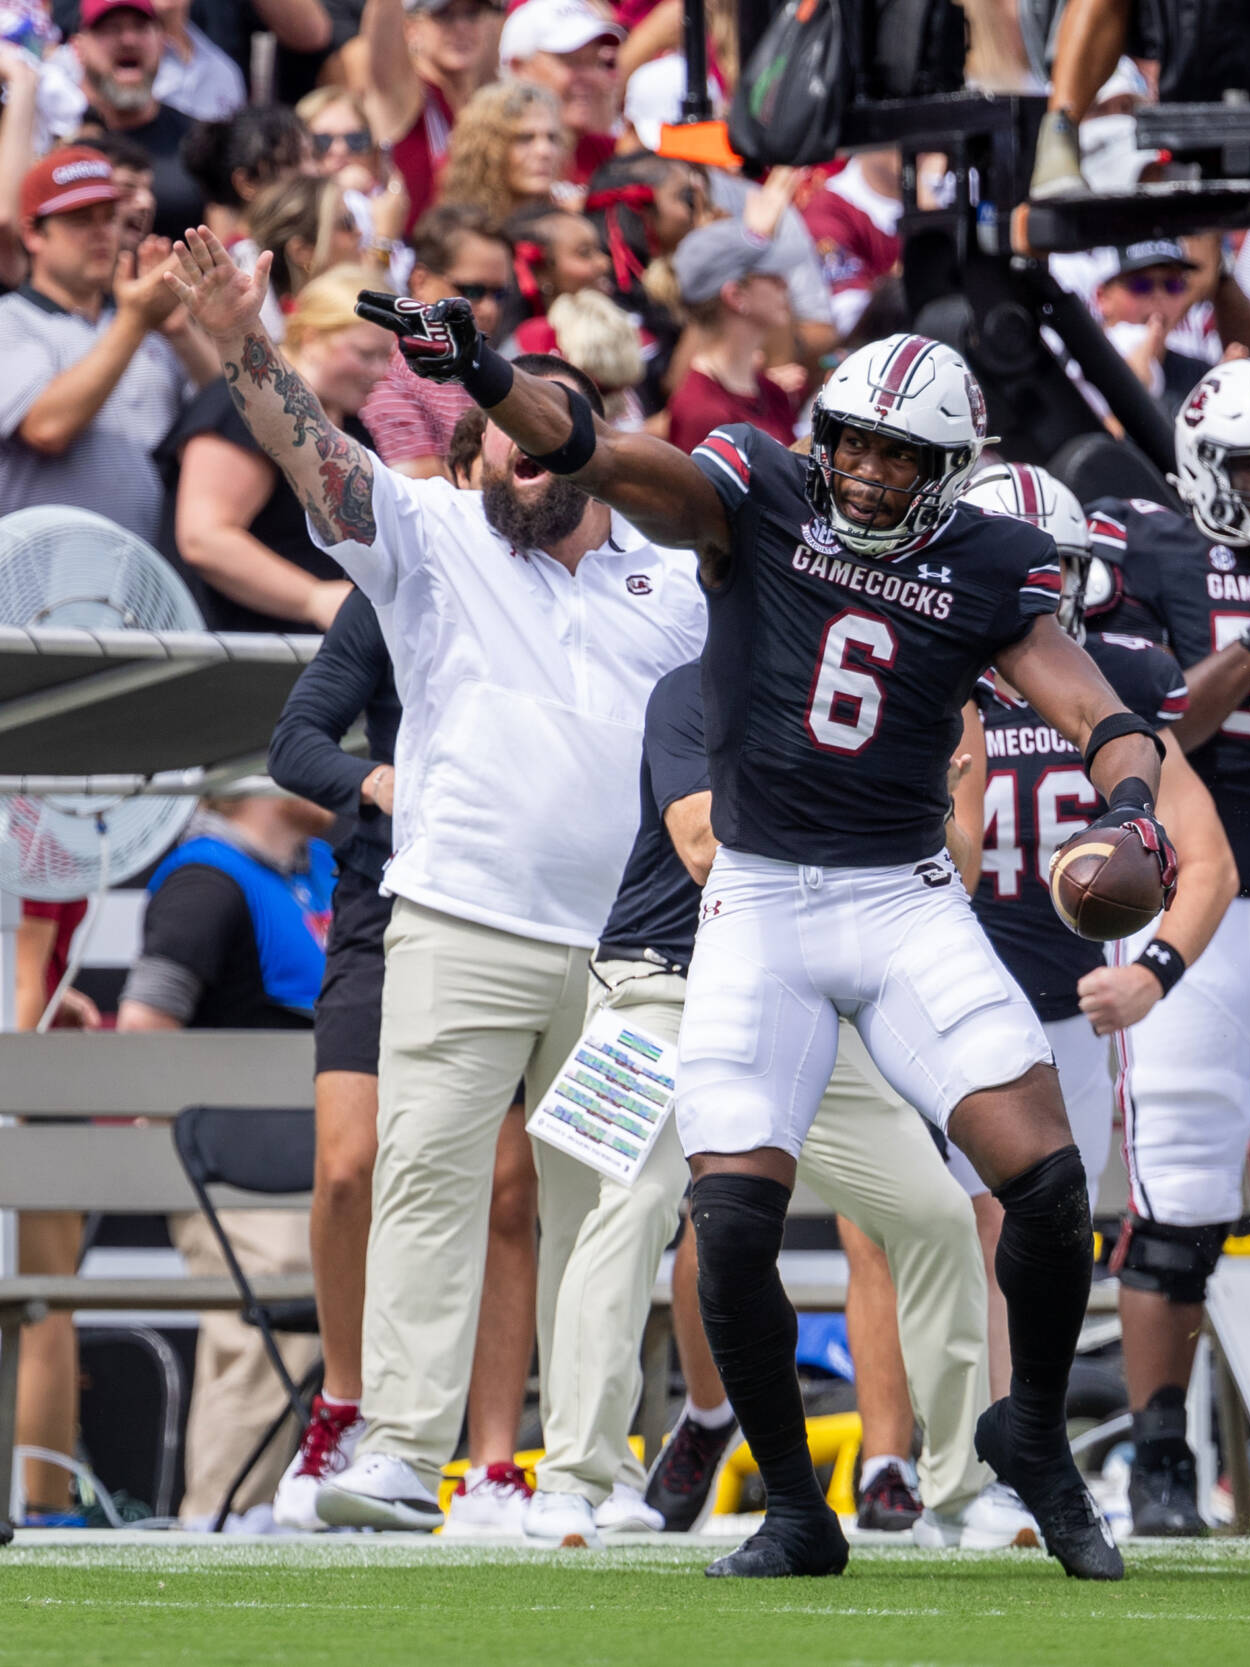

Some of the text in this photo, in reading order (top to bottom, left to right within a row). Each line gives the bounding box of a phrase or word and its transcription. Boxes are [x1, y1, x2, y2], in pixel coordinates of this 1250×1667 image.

[791, 543, 954, 621] GAMECOCKS
[803, 606, 899, 758] 6
[981, 763, 1099, 901] 46
